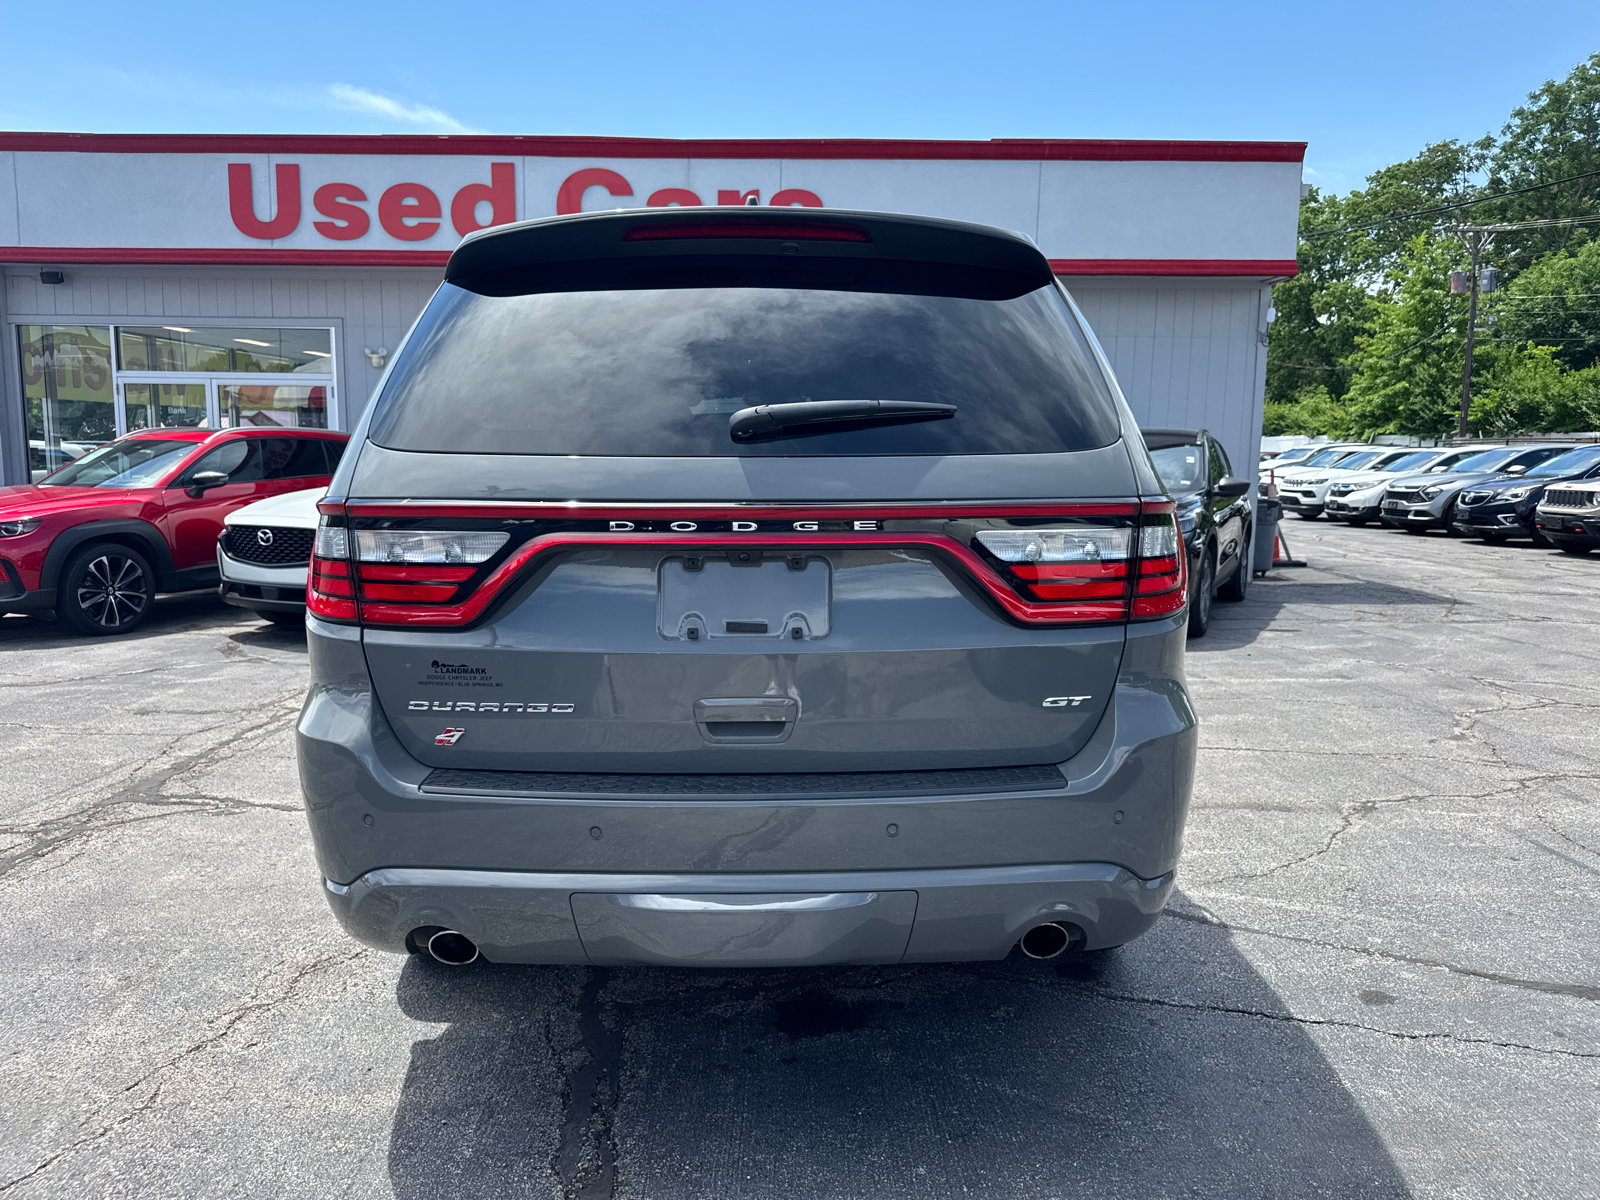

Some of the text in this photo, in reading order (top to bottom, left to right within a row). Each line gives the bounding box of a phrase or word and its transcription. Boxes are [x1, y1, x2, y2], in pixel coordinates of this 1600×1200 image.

[227, 162, 516, 241] Used
[608, 520, 878, 532] DODGE
[440, 667, 487, 675] LANDMARK
[407, 700, 575, 713] DURANGO
[1042, 695, 1092, 707] GT
